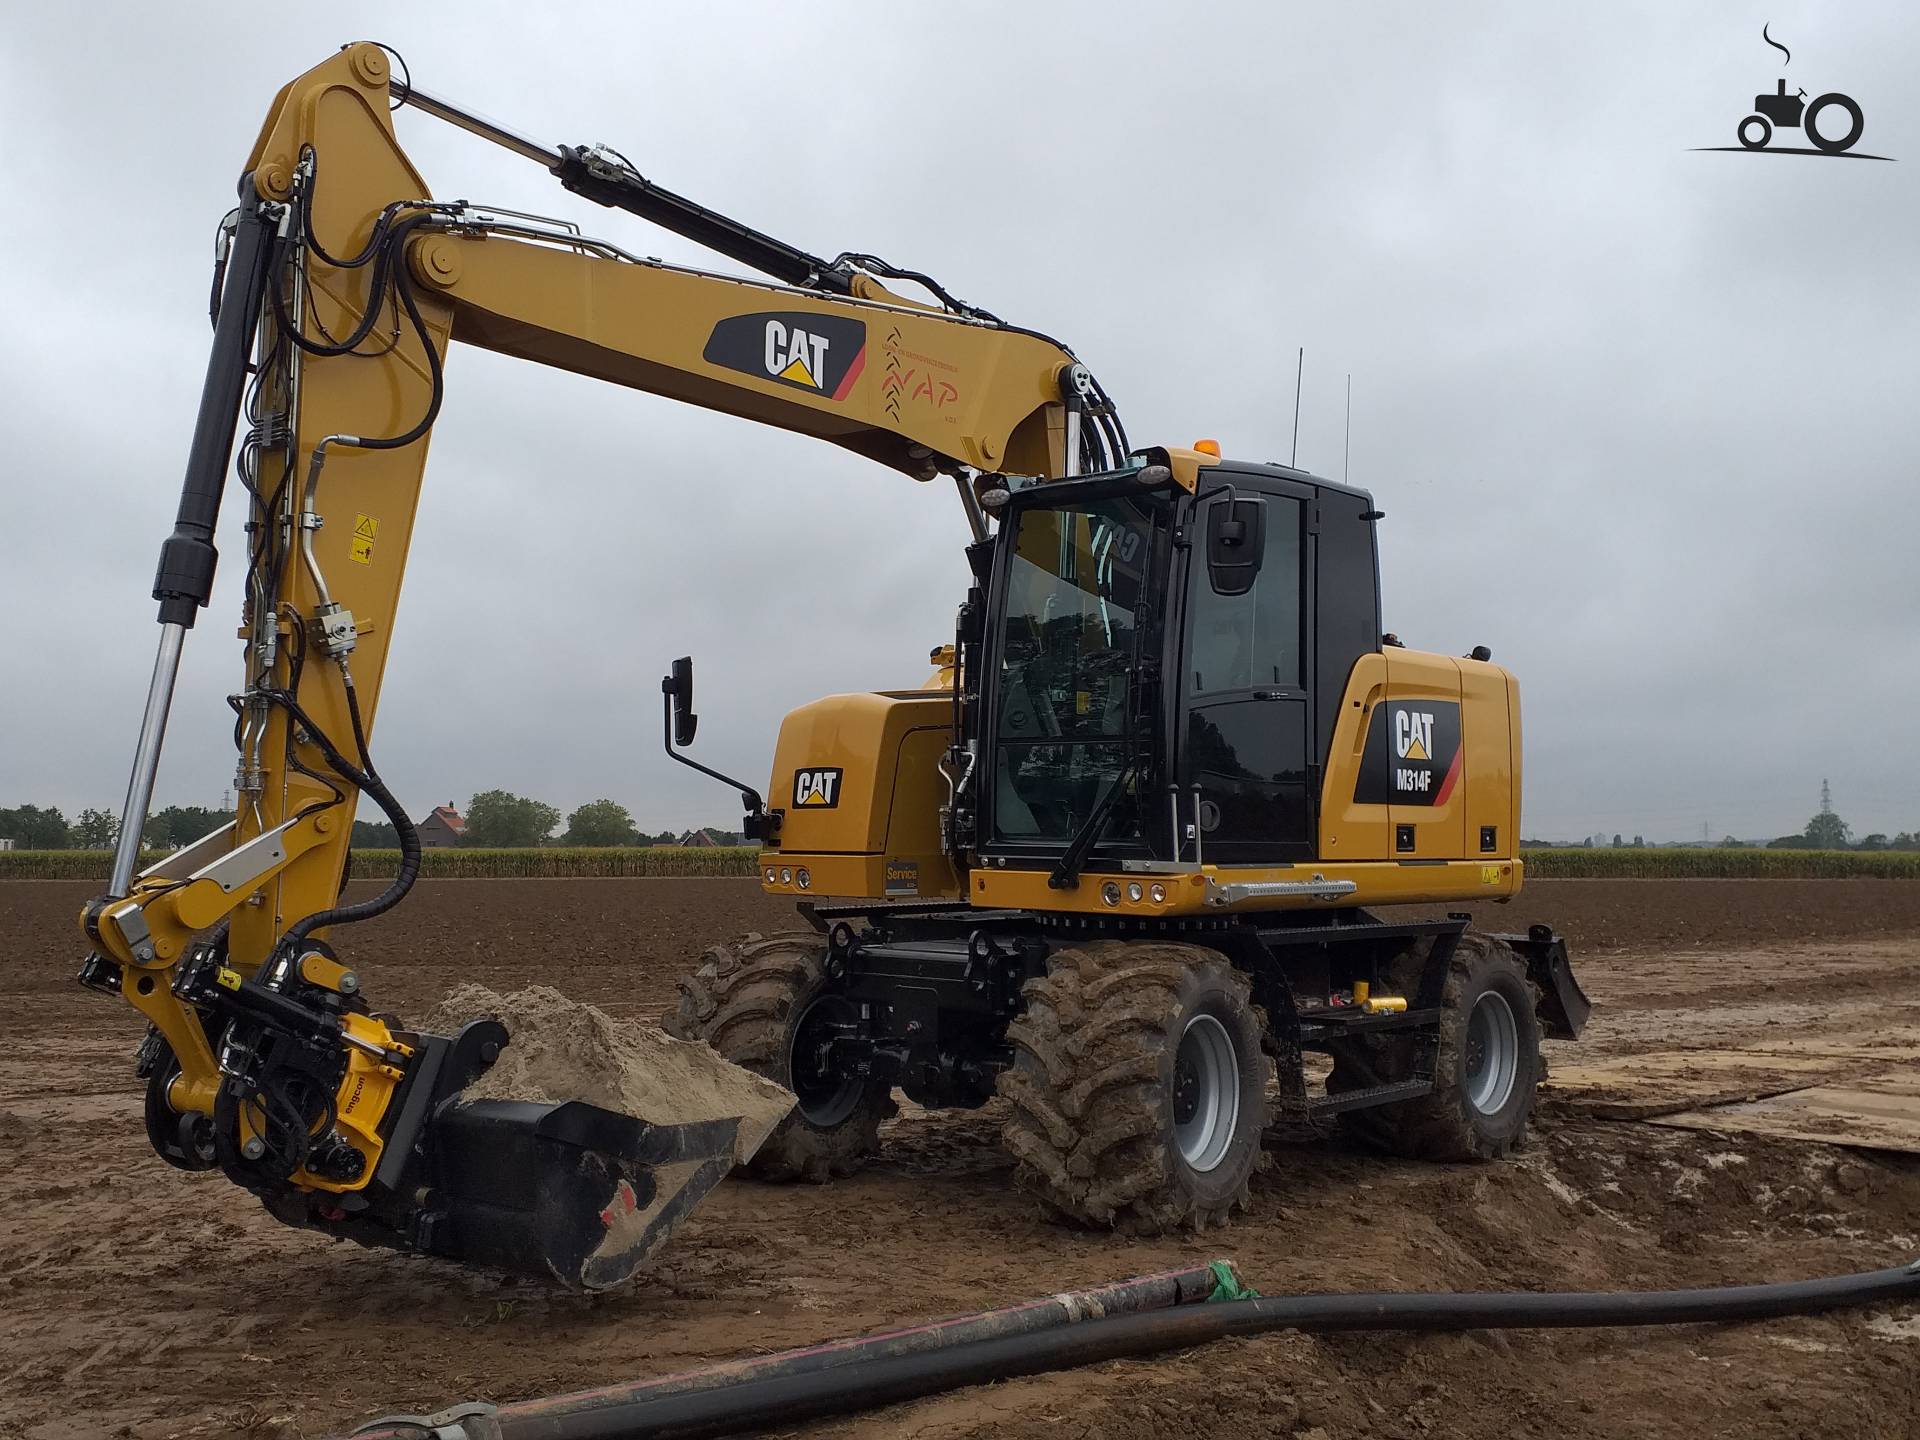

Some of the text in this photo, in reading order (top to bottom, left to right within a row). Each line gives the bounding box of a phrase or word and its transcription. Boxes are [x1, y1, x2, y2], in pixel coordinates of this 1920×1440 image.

[765, 320, 829, 389] CAT
[1396, 710, 1433, 760] CAT
[797, 772, 836, 804] CAT
[1397, 769, 1431, 791] M314F
[887, 867, 917, 880] Service
[345, 1077, 365, 1114] engcon
